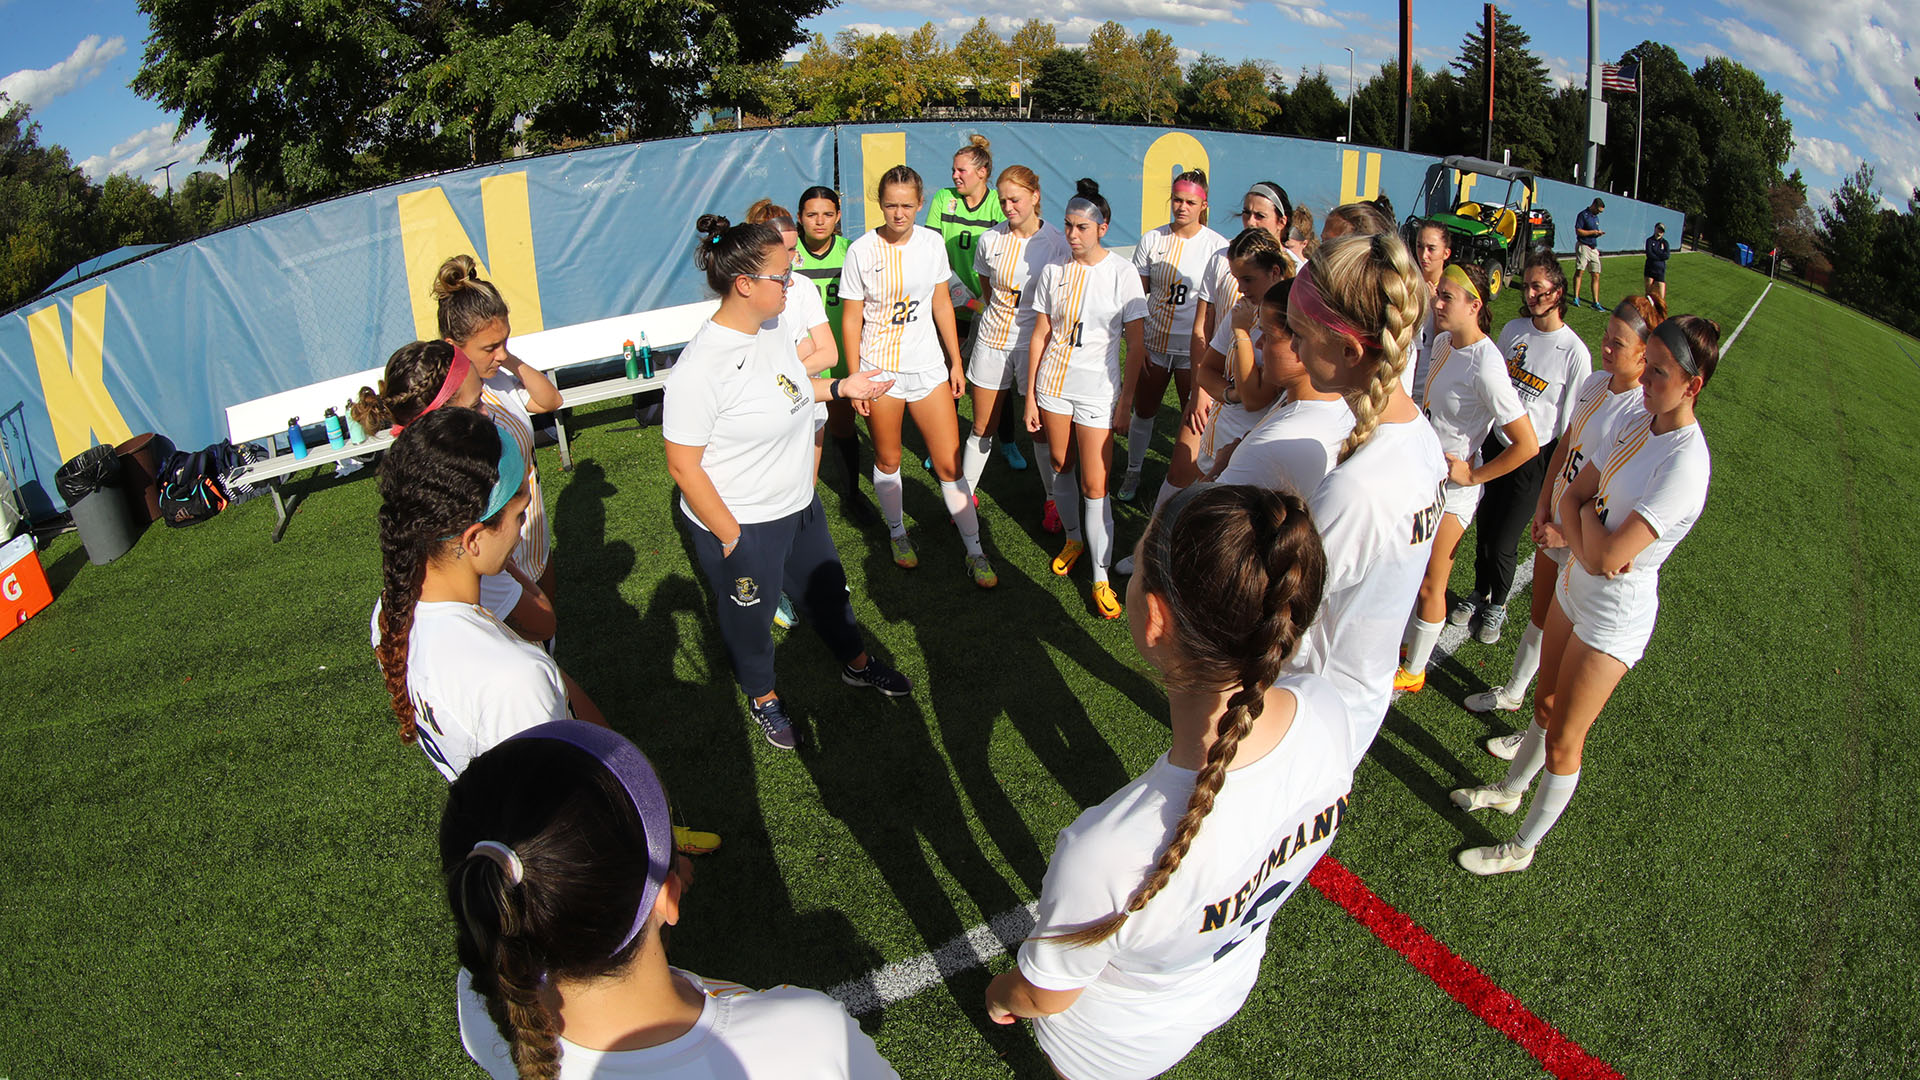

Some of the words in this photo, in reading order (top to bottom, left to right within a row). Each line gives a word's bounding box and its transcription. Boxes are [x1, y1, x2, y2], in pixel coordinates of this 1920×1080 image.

[1012, 290, 1022, 309] 7
[1167, 283, 1188, 306] 18
[892, 300, 920, 325] 22
[1069, 321, 1084, 348] 11
[1563, 448, 1584, 484] 15
[2, 572, 23, 602] G
